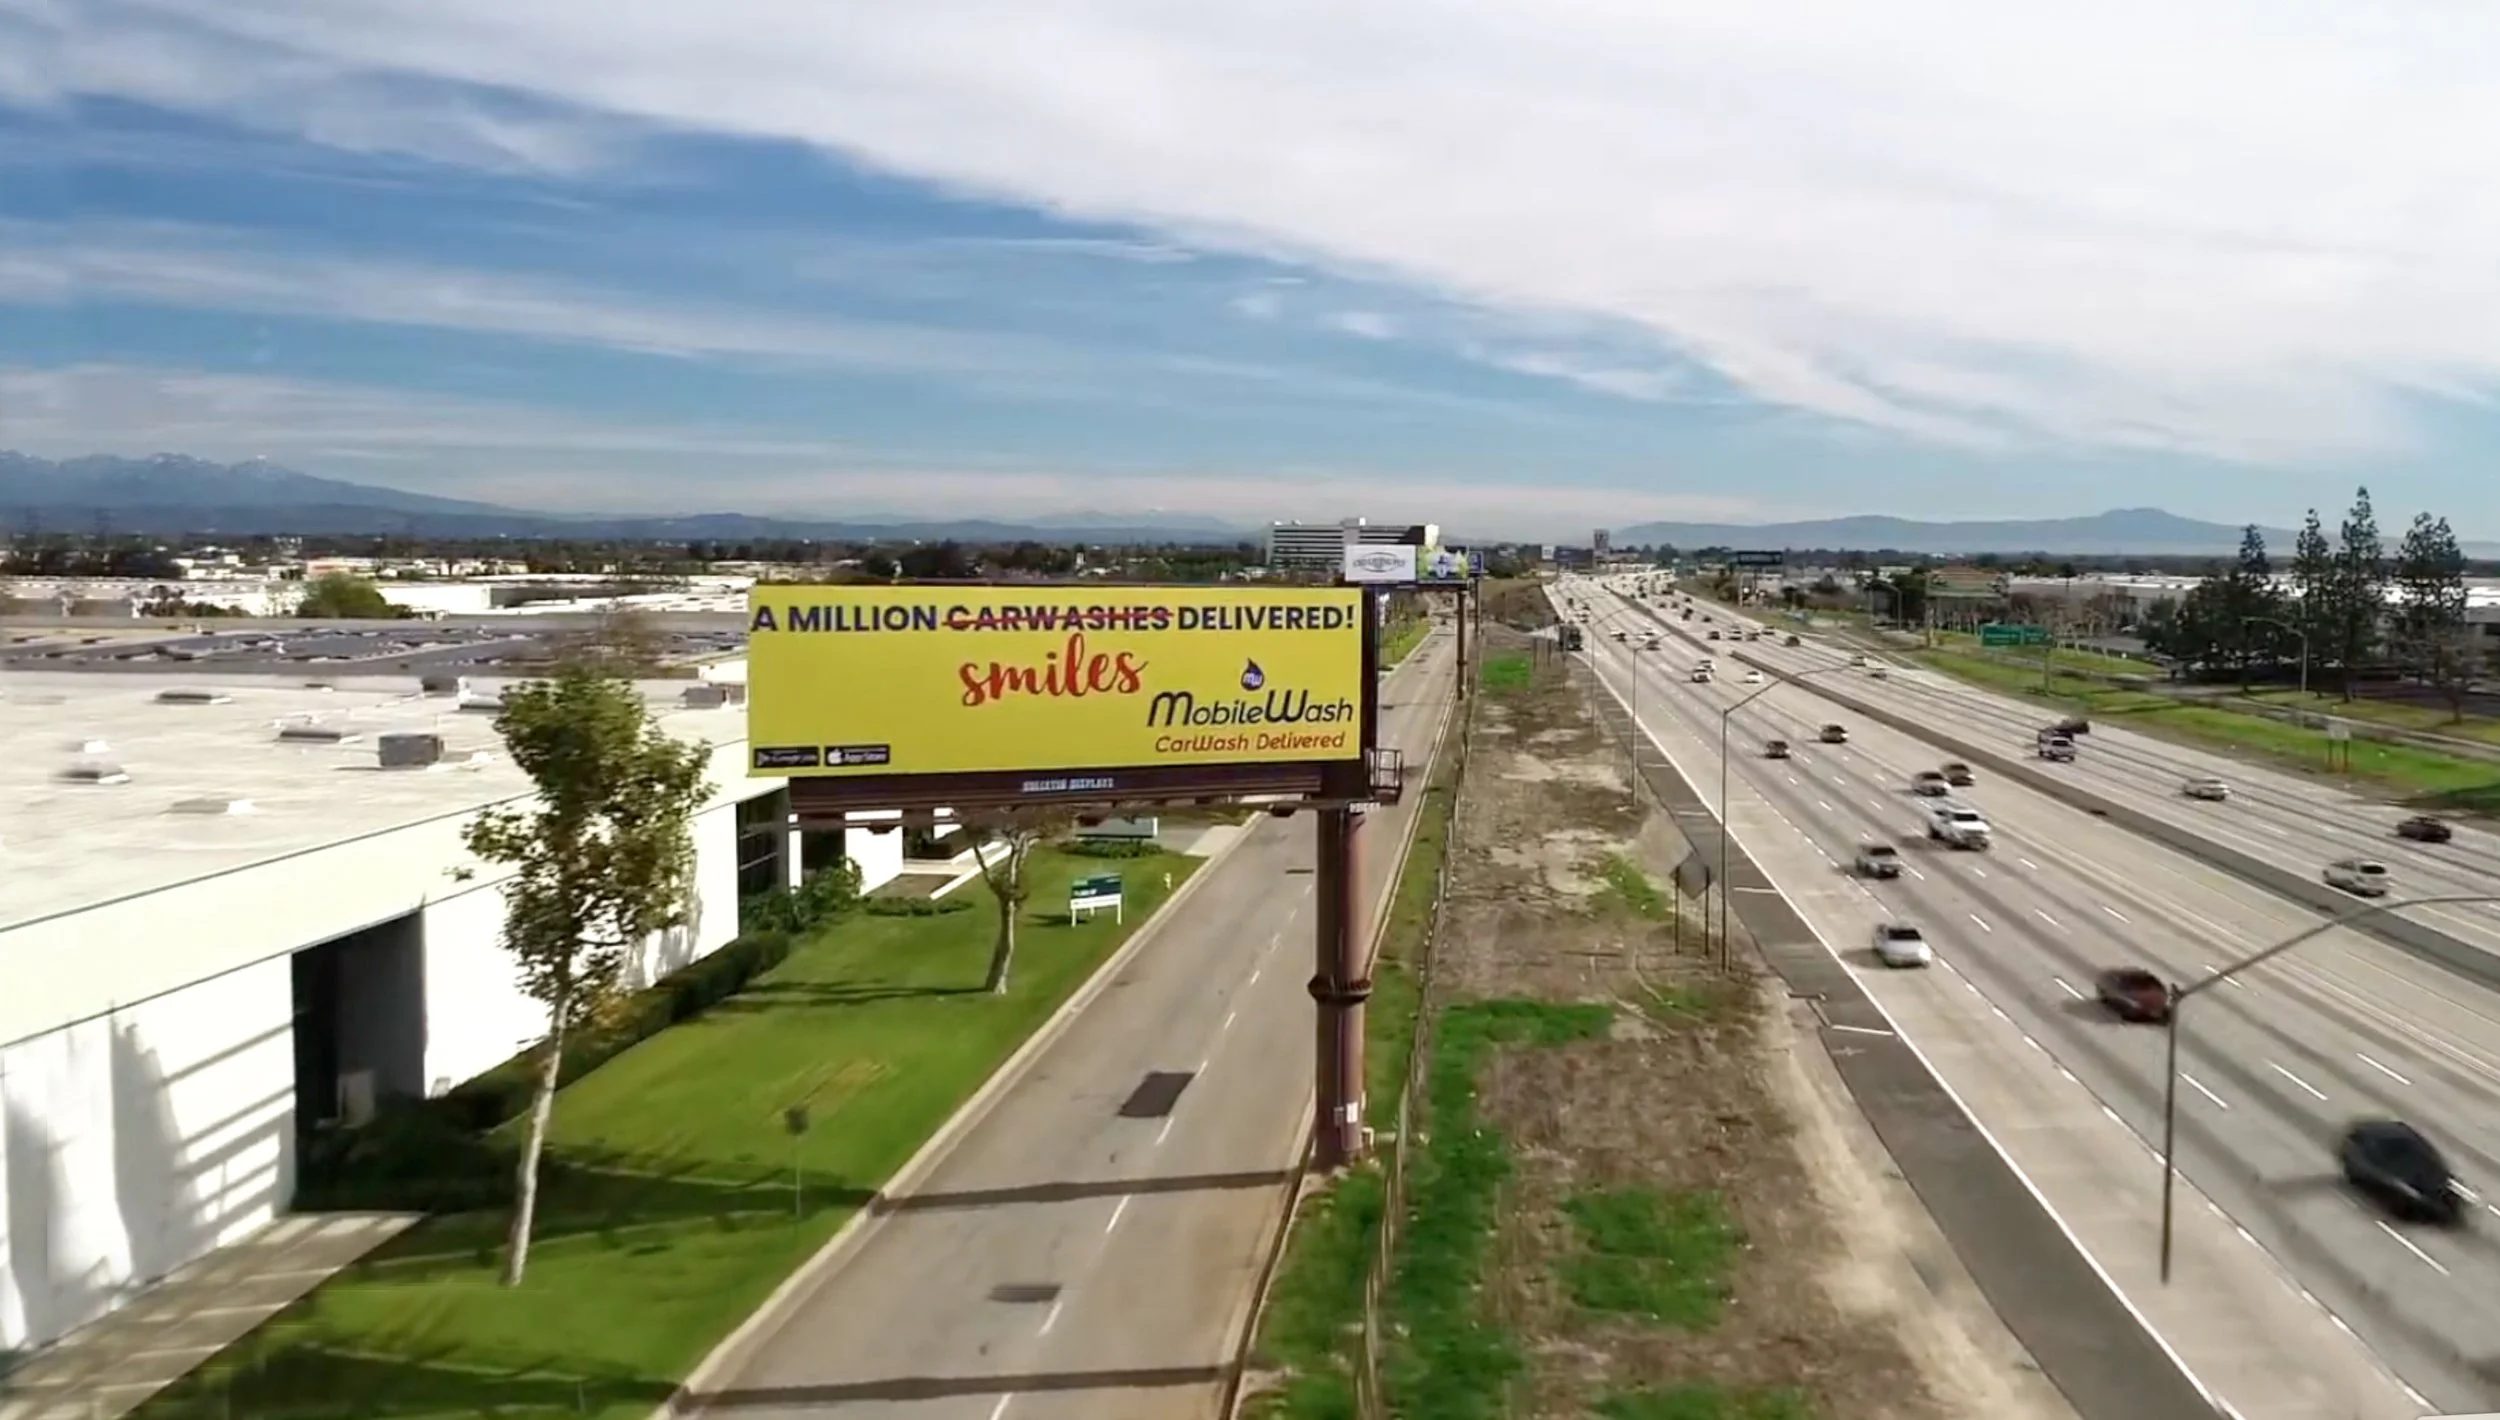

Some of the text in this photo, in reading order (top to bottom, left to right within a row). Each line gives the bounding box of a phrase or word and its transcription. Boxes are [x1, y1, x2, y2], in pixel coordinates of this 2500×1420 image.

[750, 605, 1354, 632] A MILLION CARWASHES DELIVERED!
[959, 633, 1148, 707] smiles
[1147, 690, 1353, 727] MobileWash
[1155, 731, 1345, 753] CarWash Delivered
